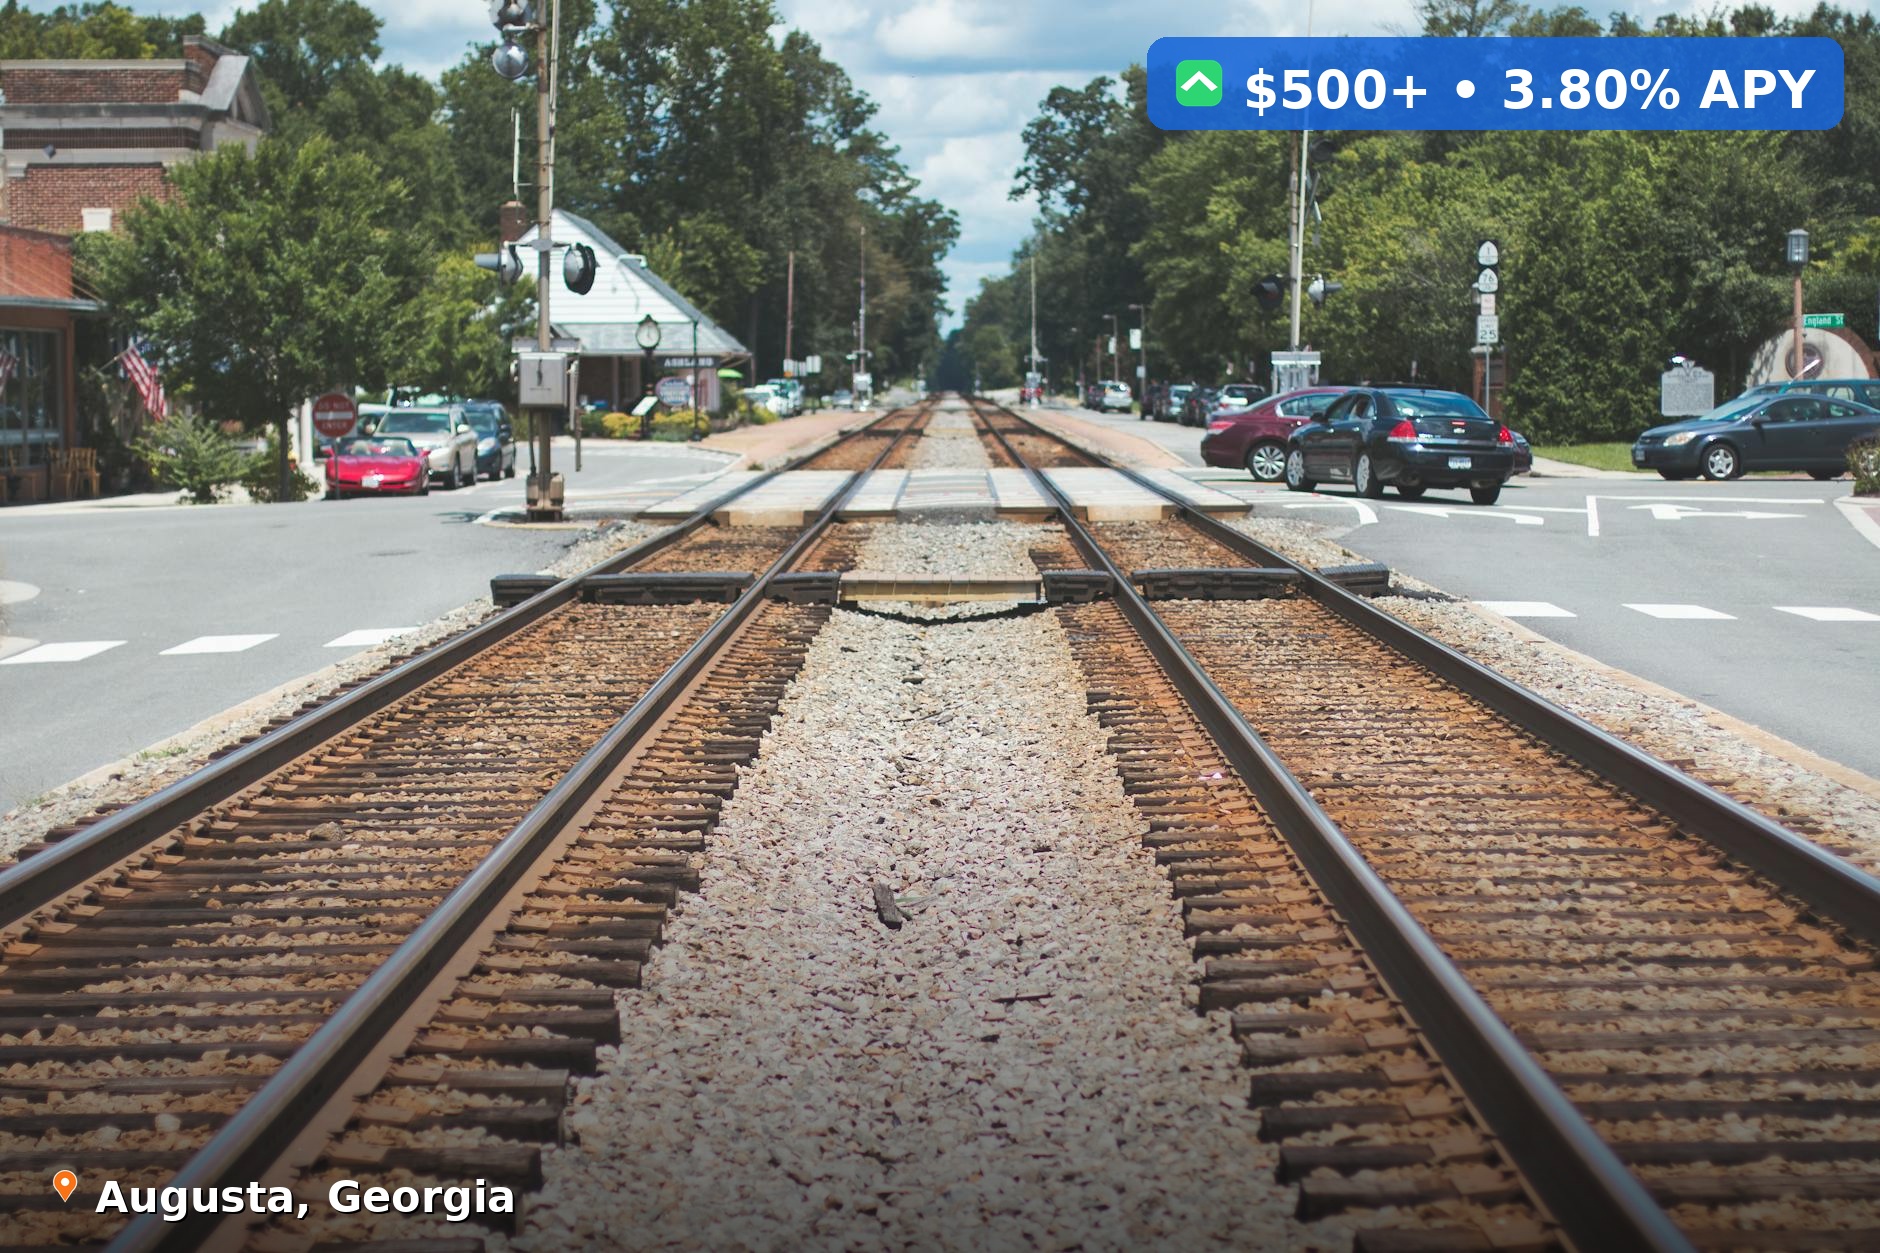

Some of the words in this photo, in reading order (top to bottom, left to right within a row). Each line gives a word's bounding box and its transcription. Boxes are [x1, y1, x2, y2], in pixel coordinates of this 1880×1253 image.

[1483, 273, 1494, 282] 76
[1804, 316, 1831, 327] England
[1836, 315, 1844, 324] St
[1480, 330, 1497, 339] 25
[664, 357, 713, 367] ASHLAND
[319, 402, 330, 410] DO
[333, 402, 351, 410] NOT
[322, 421, 349, 429] ENTER
